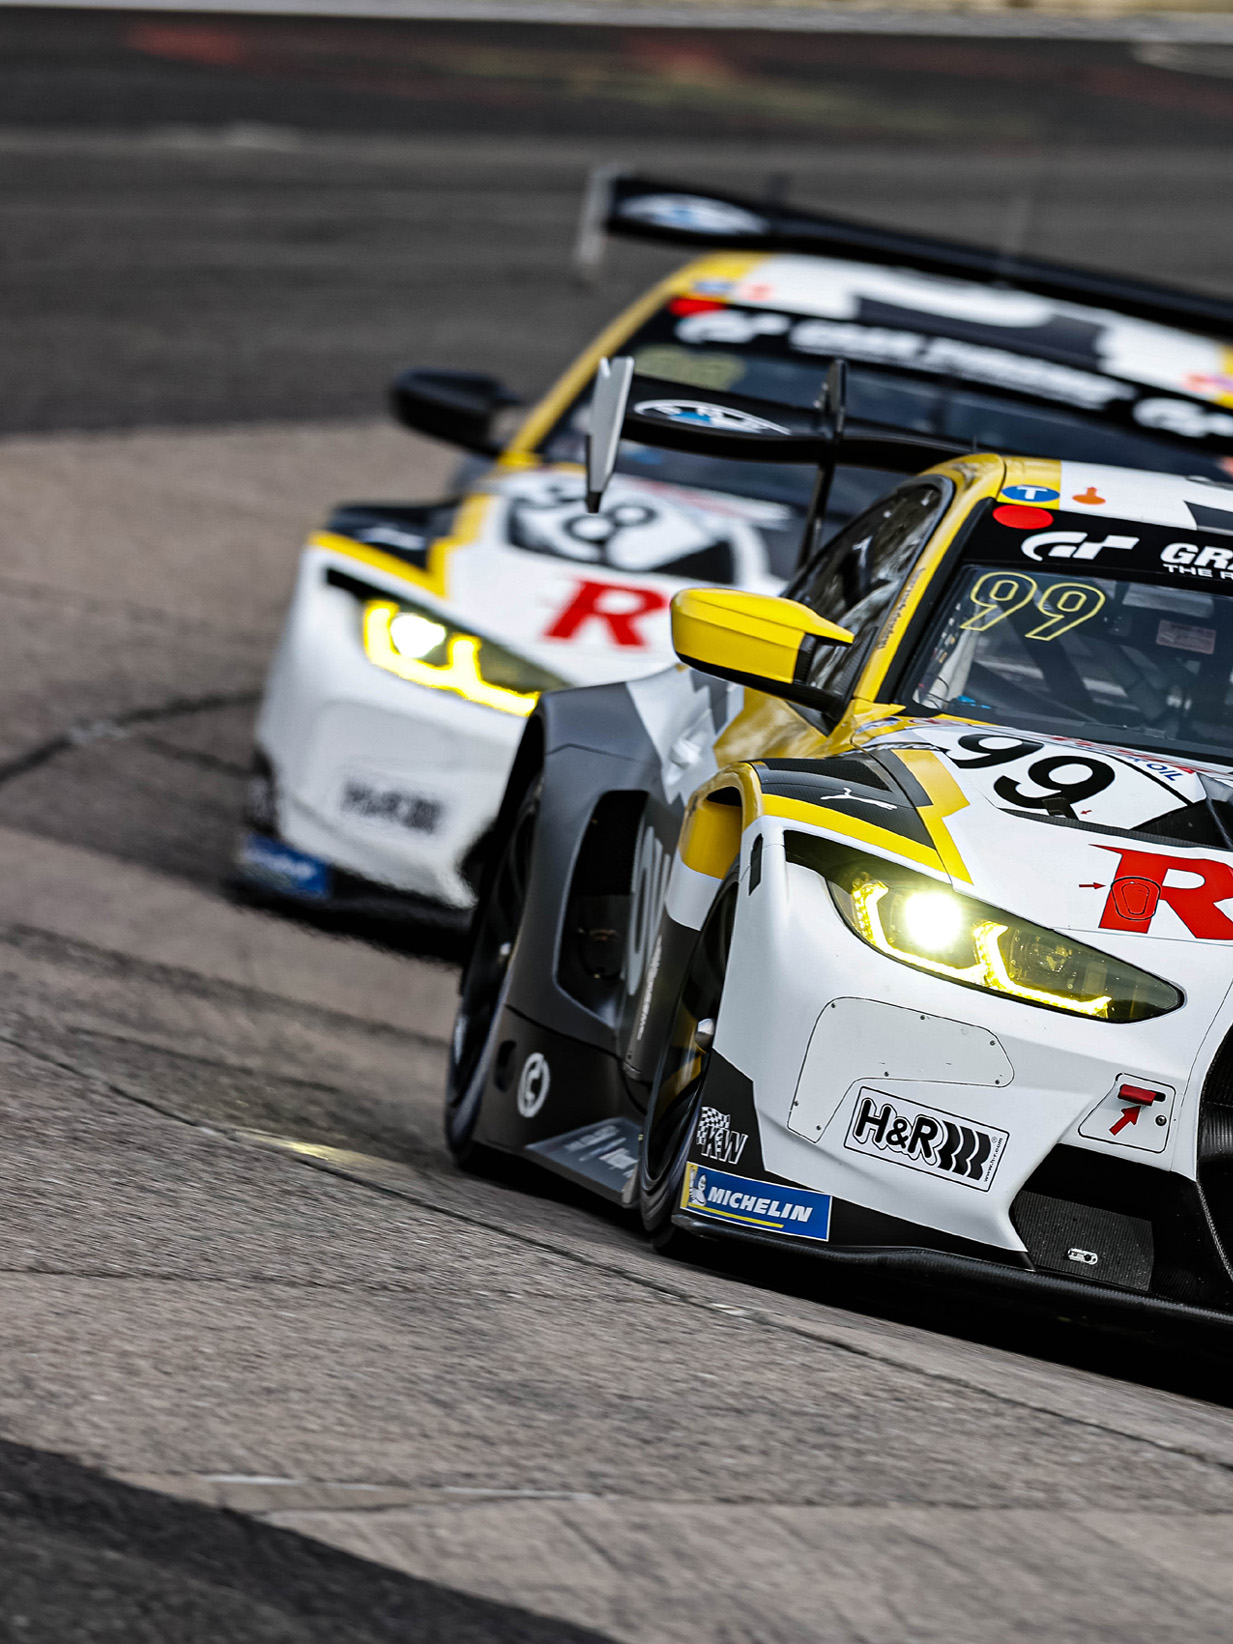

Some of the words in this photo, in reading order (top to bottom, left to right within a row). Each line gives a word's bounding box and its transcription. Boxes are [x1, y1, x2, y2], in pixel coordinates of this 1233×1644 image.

[1020, 531, 1140, 561] GT
[1162, 563, 1213, 578] THE
[959, 571, 1106, 642] 99
[944, 733, 1116, 811] 99
[700, 1124, 749, 1165] KW
[853, 1097, 944, 1166] H&R
[706, 1186, 813, 1223] MICHELIN
